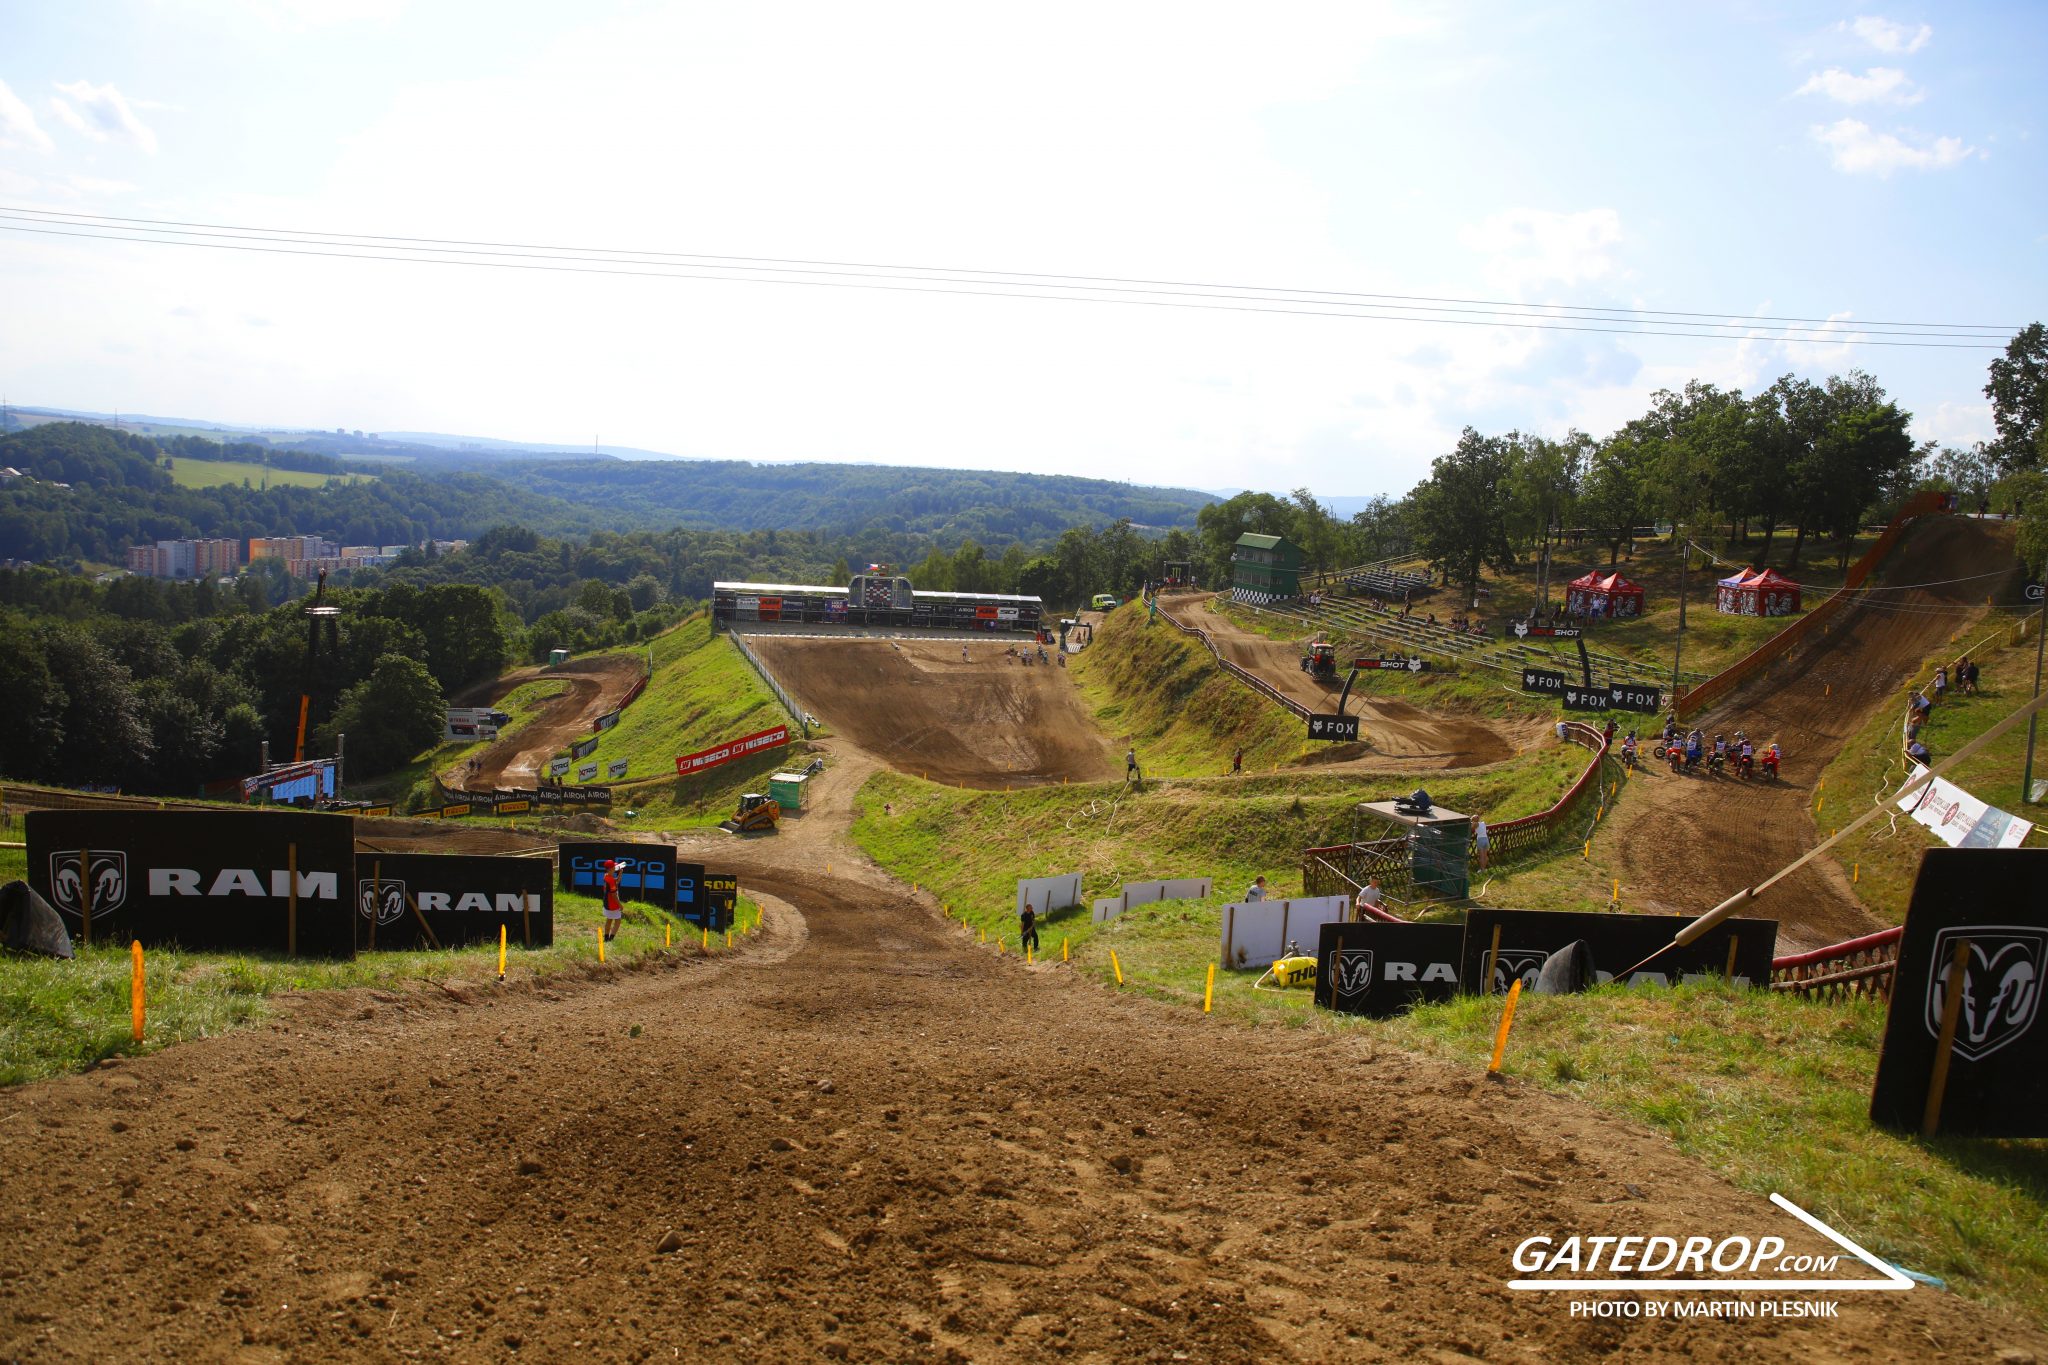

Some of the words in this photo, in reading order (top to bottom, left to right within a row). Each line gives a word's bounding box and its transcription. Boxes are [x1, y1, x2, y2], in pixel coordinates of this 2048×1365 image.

[1538, 676, 1562, 689] FOX
[1580, 694, 1607, 707] FOX
[1626, 692, 1655, 706] FOX
[1326, 722, 1355, 734] FOX
[540, 790, 561, 801] AIROH
[563, 790, 586, 801] AIROH
[587, 790, 610, 800] AIROH
[571, 855, 665, 873] GoPro
[149, 868, 338, 900] RAM
[418, 891, 541, 913] RAM
